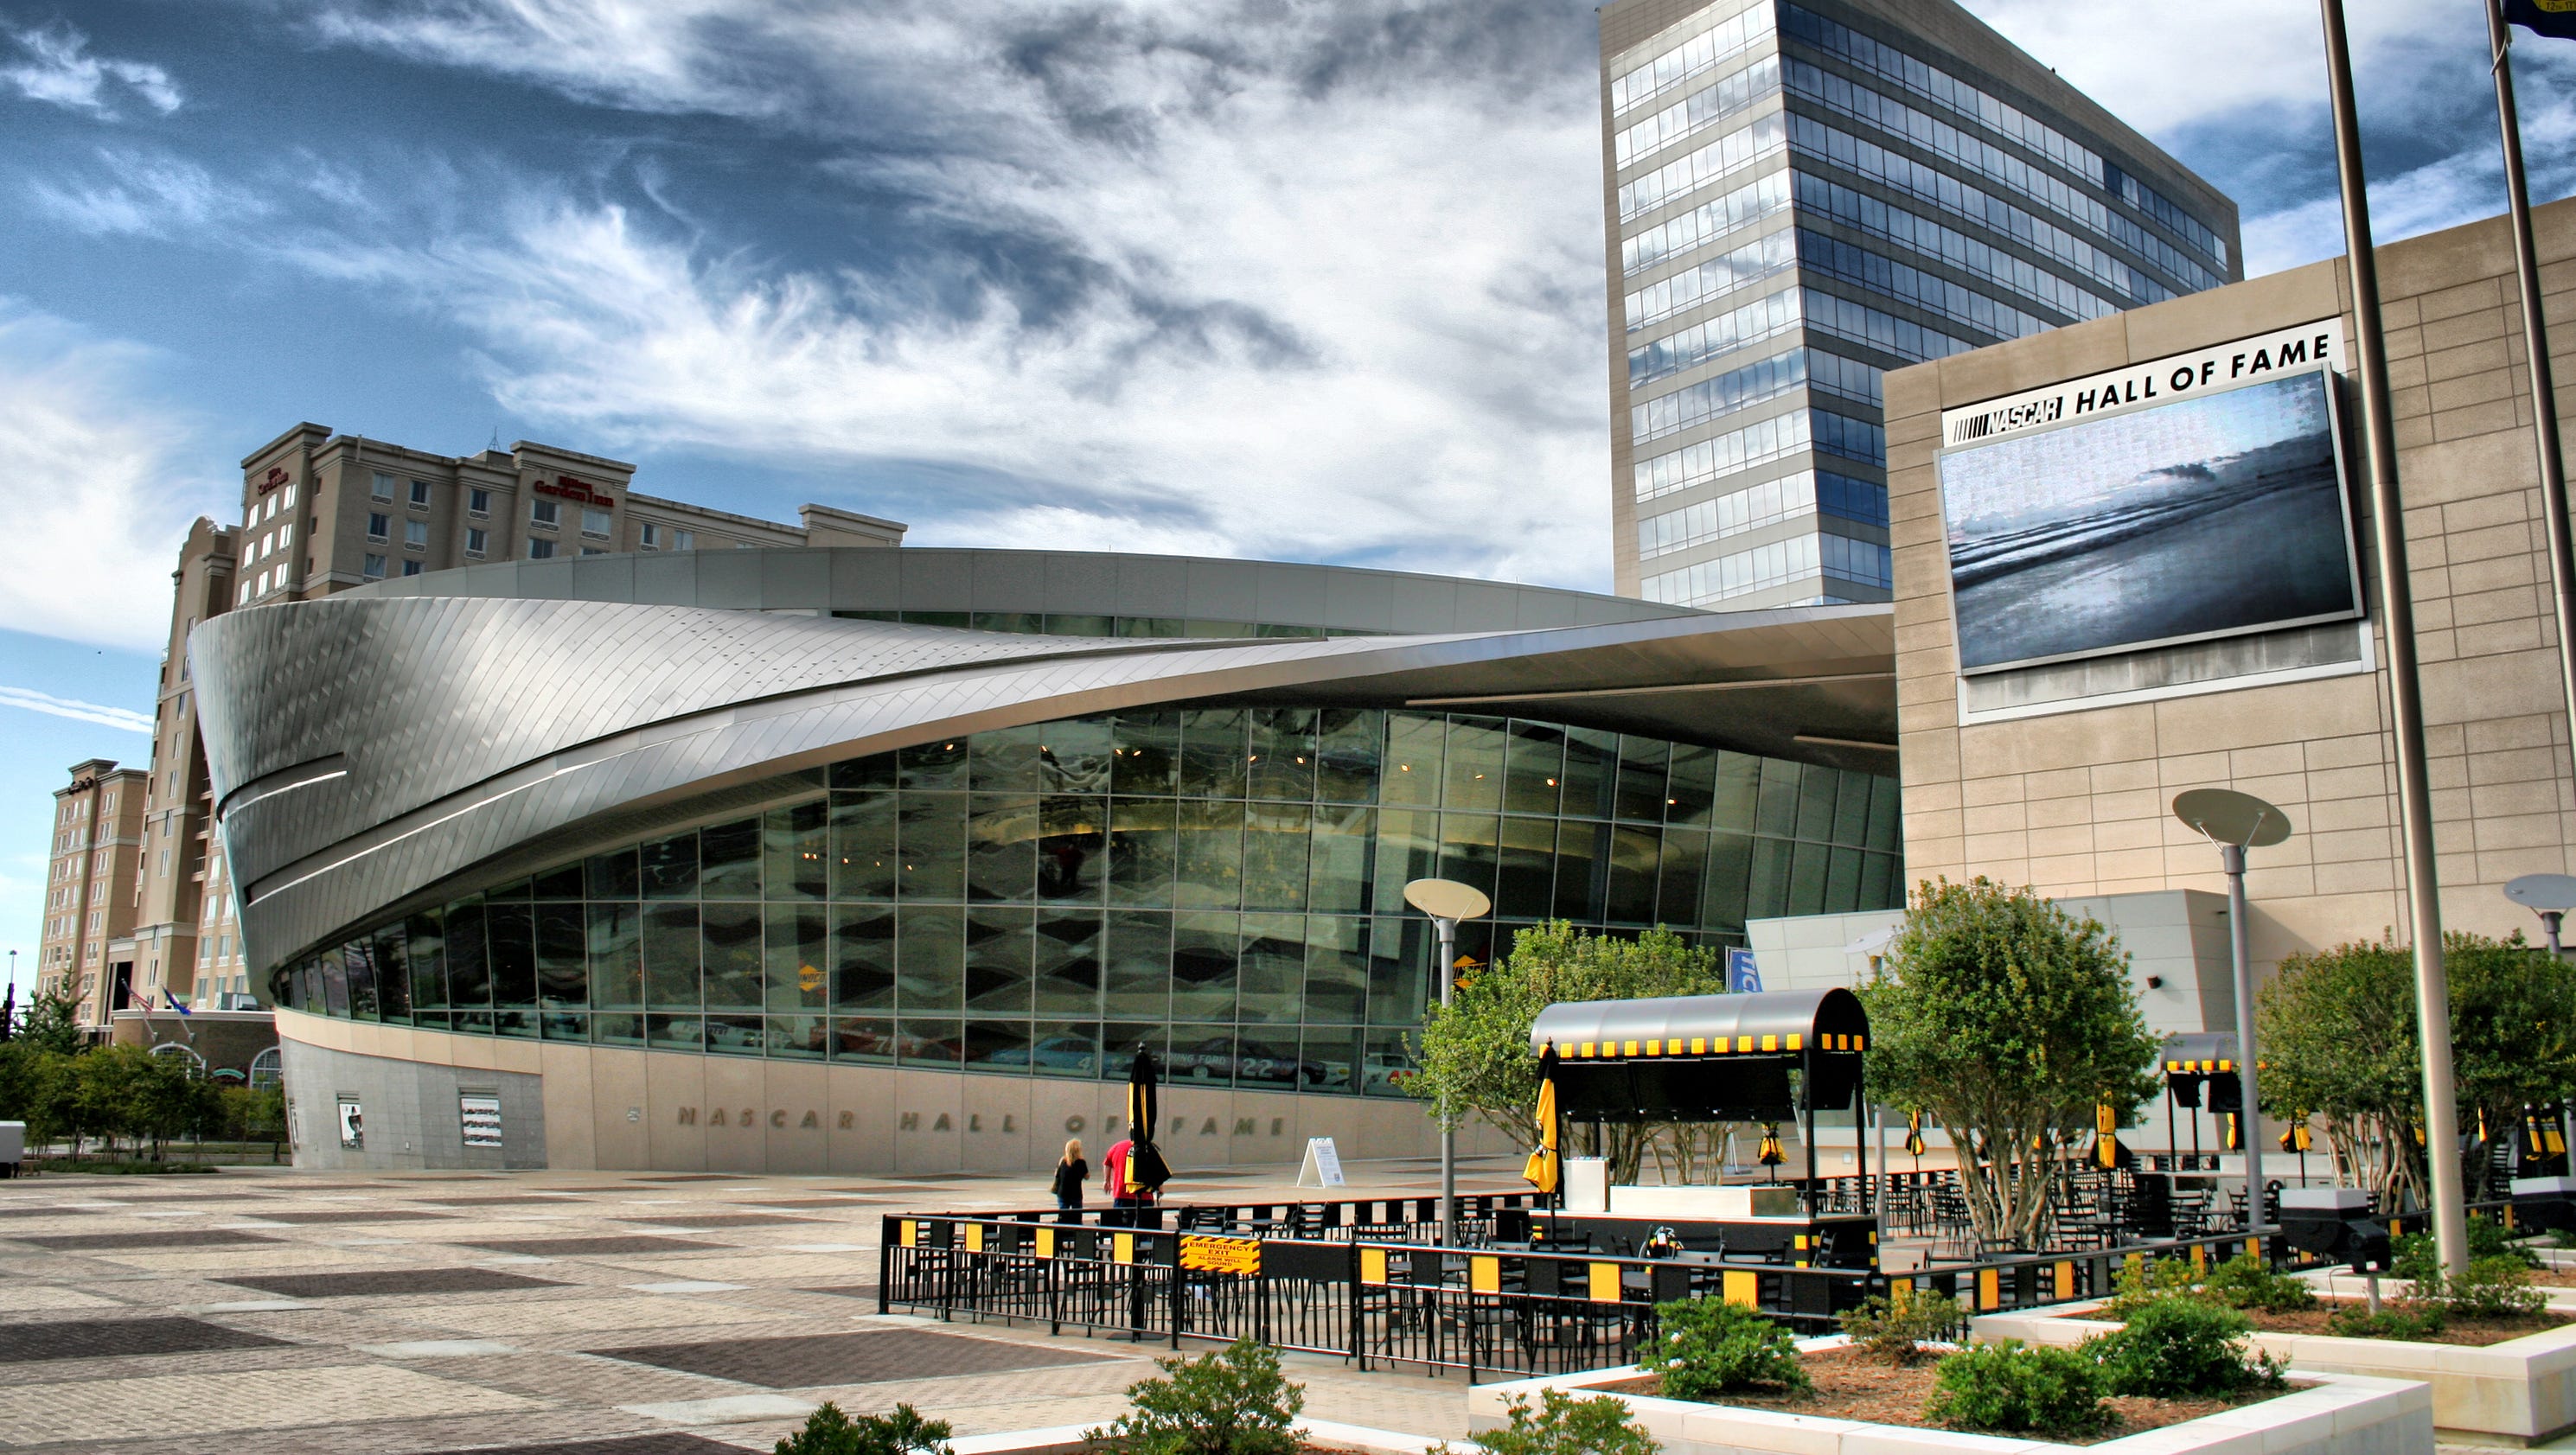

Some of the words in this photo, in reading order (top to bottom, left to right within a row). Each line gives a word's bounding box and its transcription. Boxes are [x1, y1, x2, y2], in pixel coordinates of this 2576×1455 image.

[1985, 396, 2063, 435] NASCAR
[2075, 376, 2157, 414] HALL
[2170, 361, 2215, 392] OF
[2231, 334, 2329, 379] FAME
[534, 481, 585, 501] Garden
[587, 491, 614, 507] Inn
[1741, 954, 1757, 992] TIC
[1160, 1051, 1193, 1063] YOUNG
[1199, 1054, 1226, 1066] FORD
[1242, 1057, 1274, 1078] 22
[678, 1106, 854, 1129] NASCAR
[899, 1112, 1015, 1133] HALL
[1064, 1114, 1119, 1133] OF
[1171, 1116, 1284, 1136] FAME
[1189, 1241, 1250, 1252] EMERGENCY
